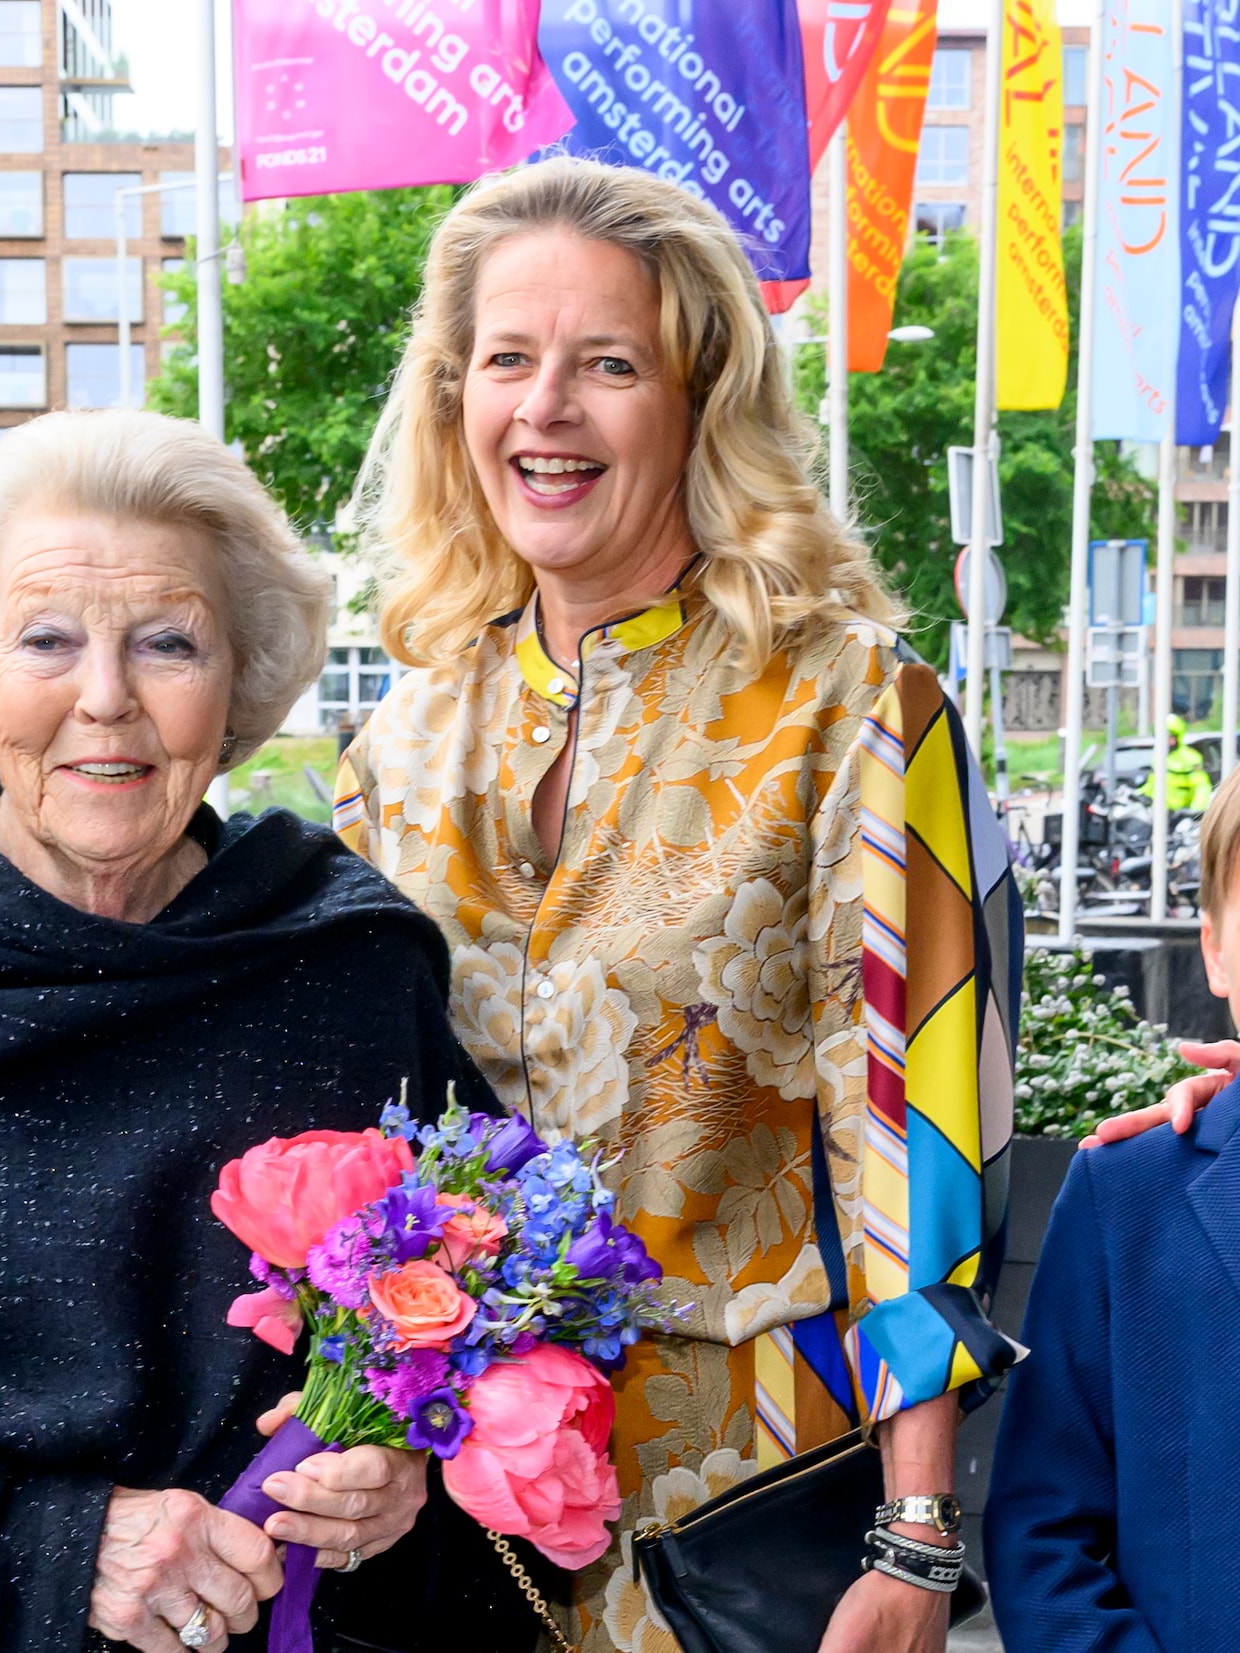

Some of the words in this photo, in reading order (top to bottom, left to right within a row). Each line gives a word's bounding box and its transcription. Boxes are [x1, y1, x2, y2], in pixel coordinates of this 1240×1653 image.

[562, 51, 724, 215] amsterda
[563, 0, 731, 185] performing
[728, 178, 786, 243] arts
